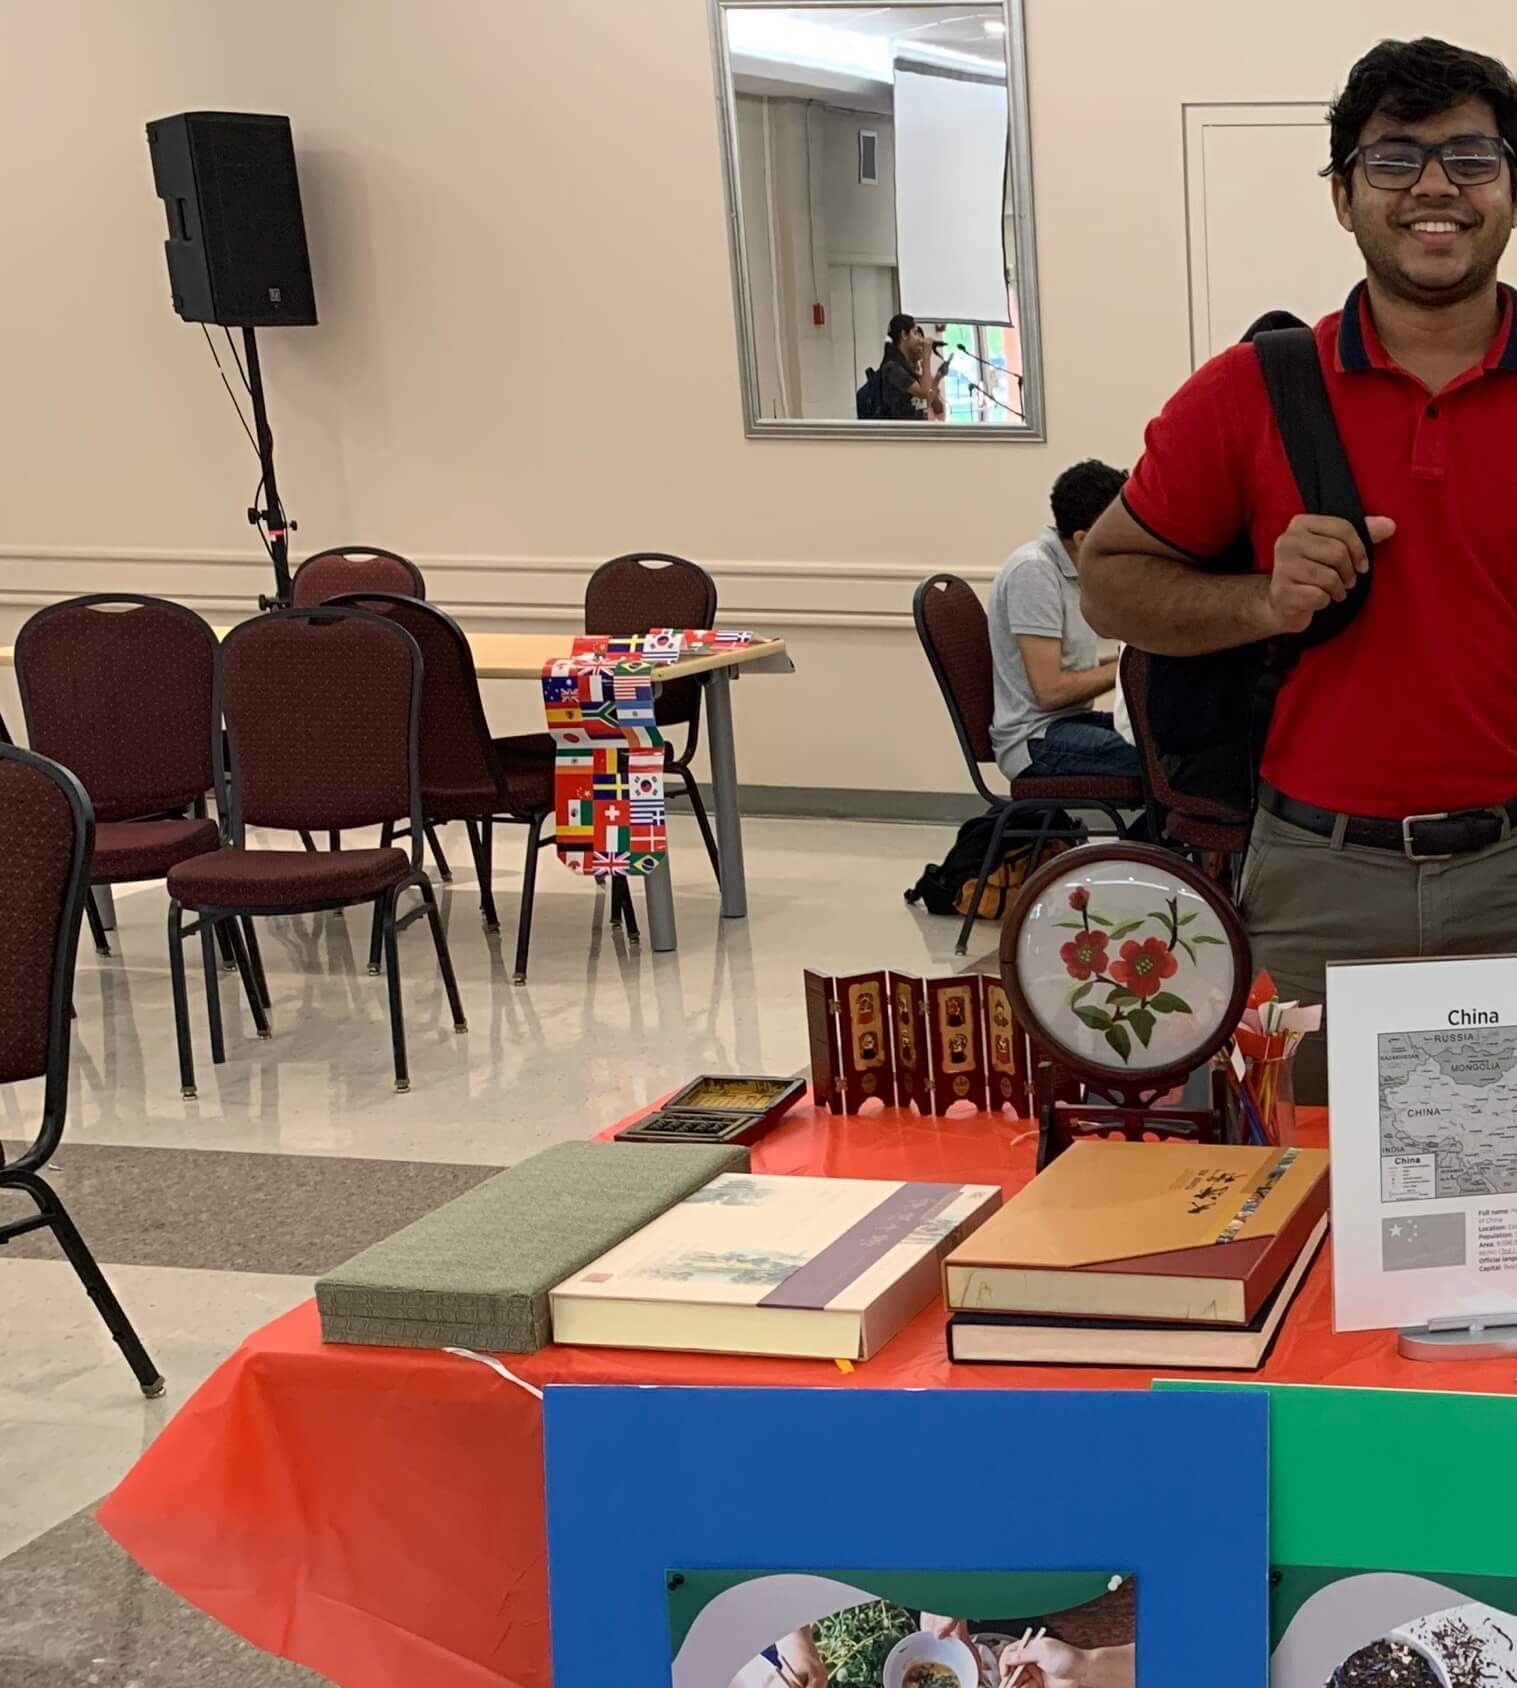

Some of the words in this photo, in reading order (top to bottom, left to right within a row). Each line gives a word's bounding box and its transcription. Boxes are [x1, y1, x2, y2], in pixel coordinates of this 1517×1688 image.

[1447, 1008, 1500, 1026] China
[1434, 1033, 1475, 1043] RUSSIA
[1451, 1062, 1501, 1072] MONGOLIA
[1407, 1107, 1441, 1118] CHINA
[1382, 1146, 1406, 1154] INDIA
[1394, 1156, 1421, 1165] China
